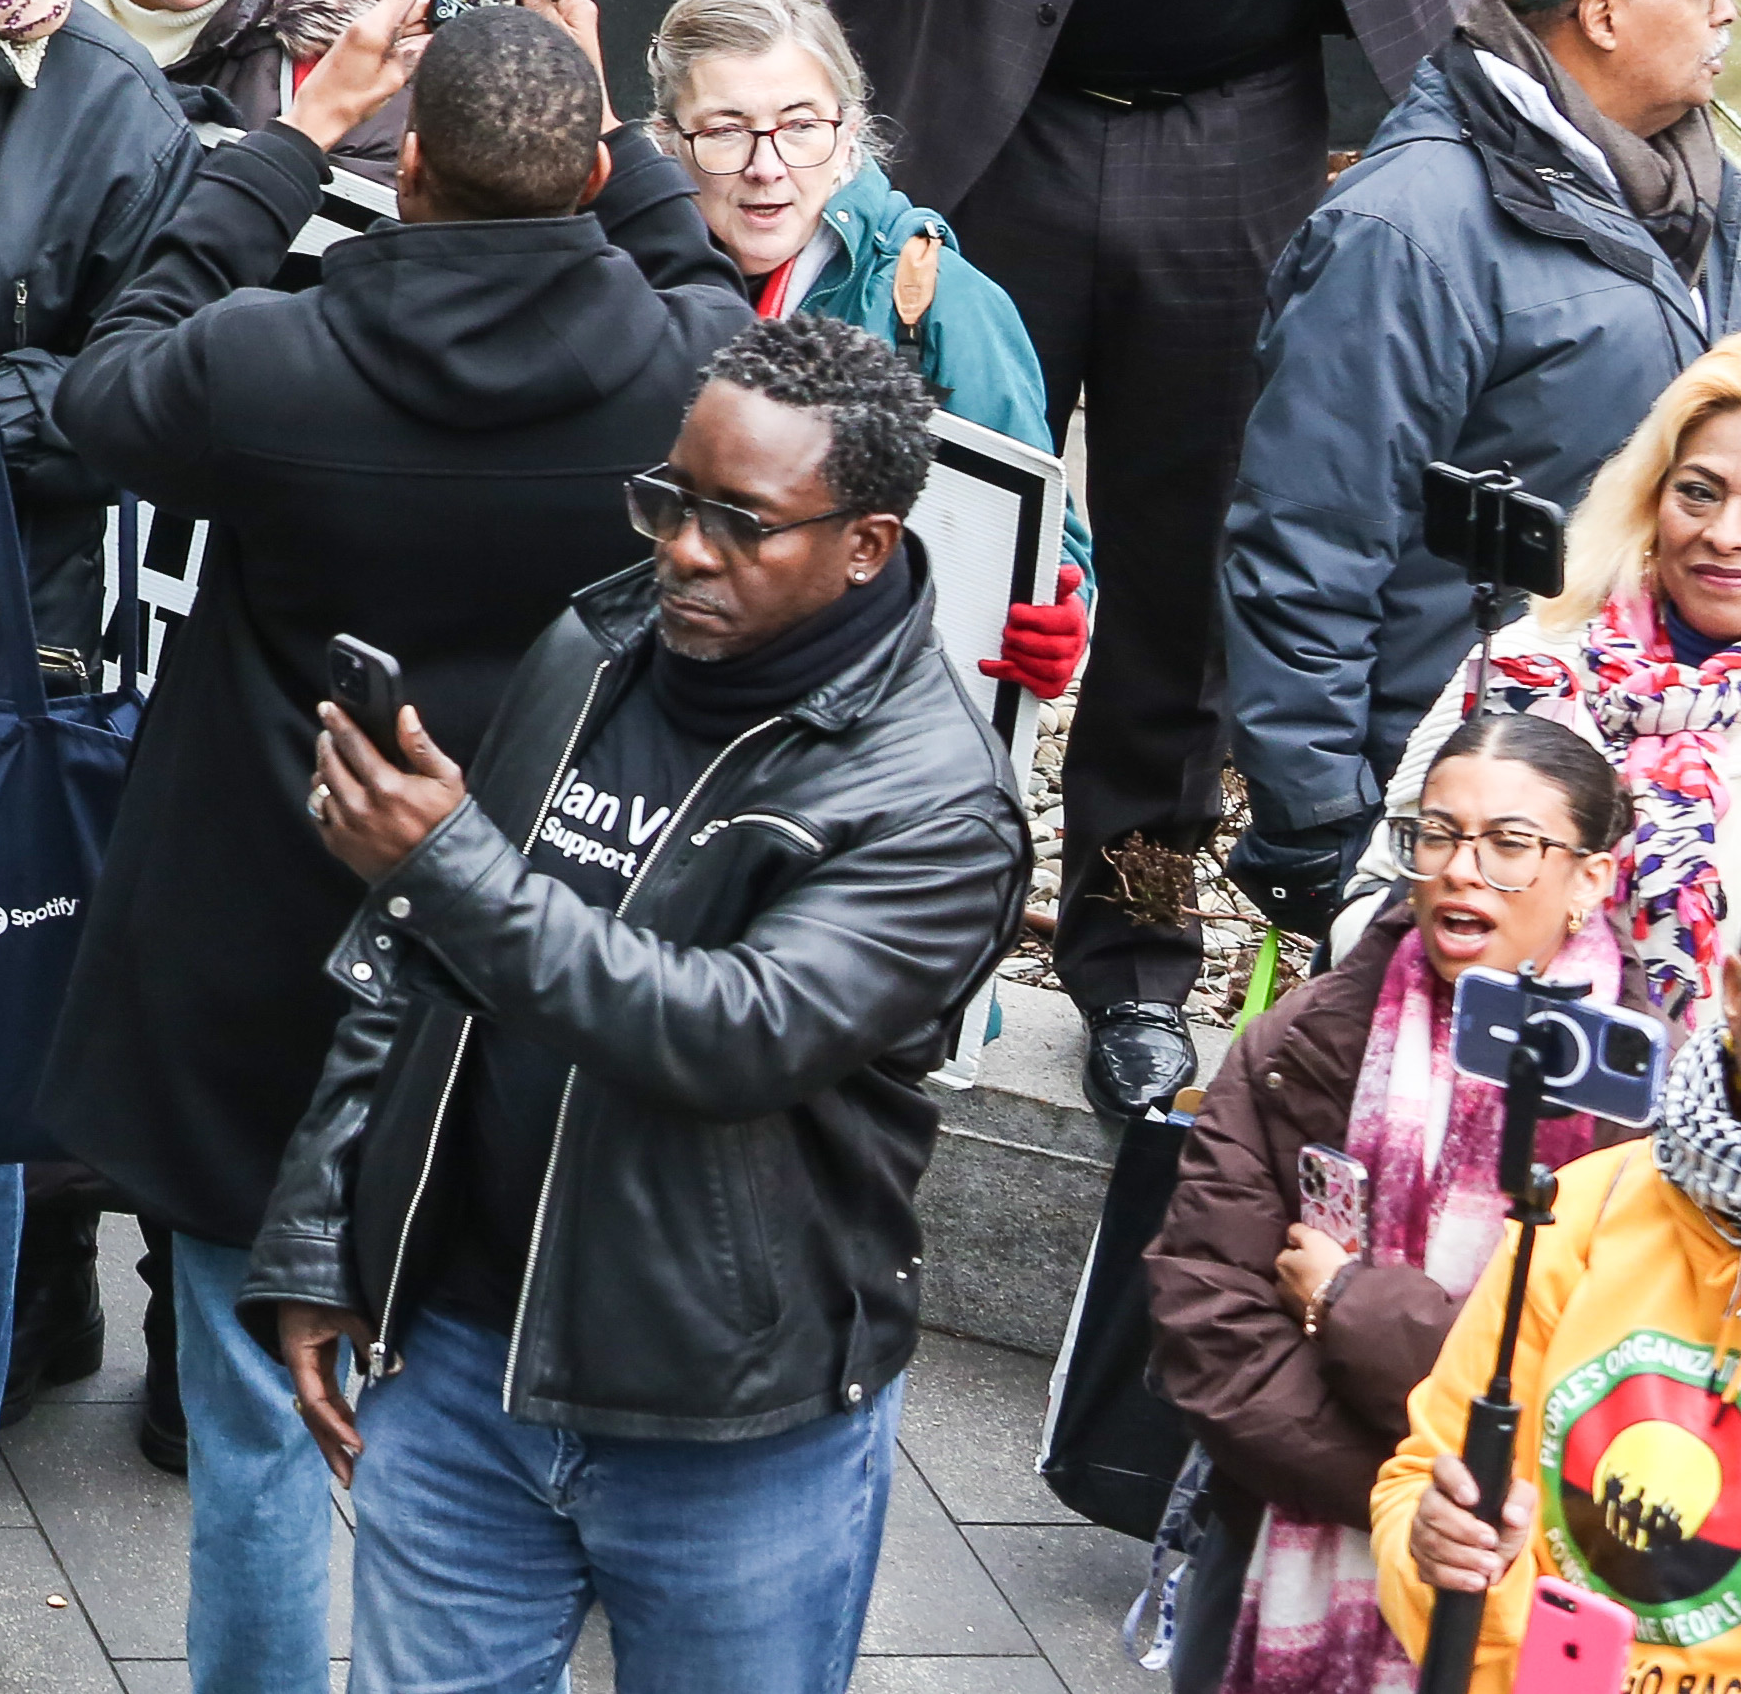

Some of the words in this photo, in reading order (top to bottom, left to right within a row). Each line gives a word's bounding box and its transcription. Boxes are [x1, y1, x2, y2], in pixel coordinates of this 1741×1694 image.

[539, 816, 638, 879] Support
[11, 896, 78, 928] Spotify
[1539, 1362, 1608, 1469] PEOPLE'S
[1661, 1590, 1741, 1646] PEOPLE
